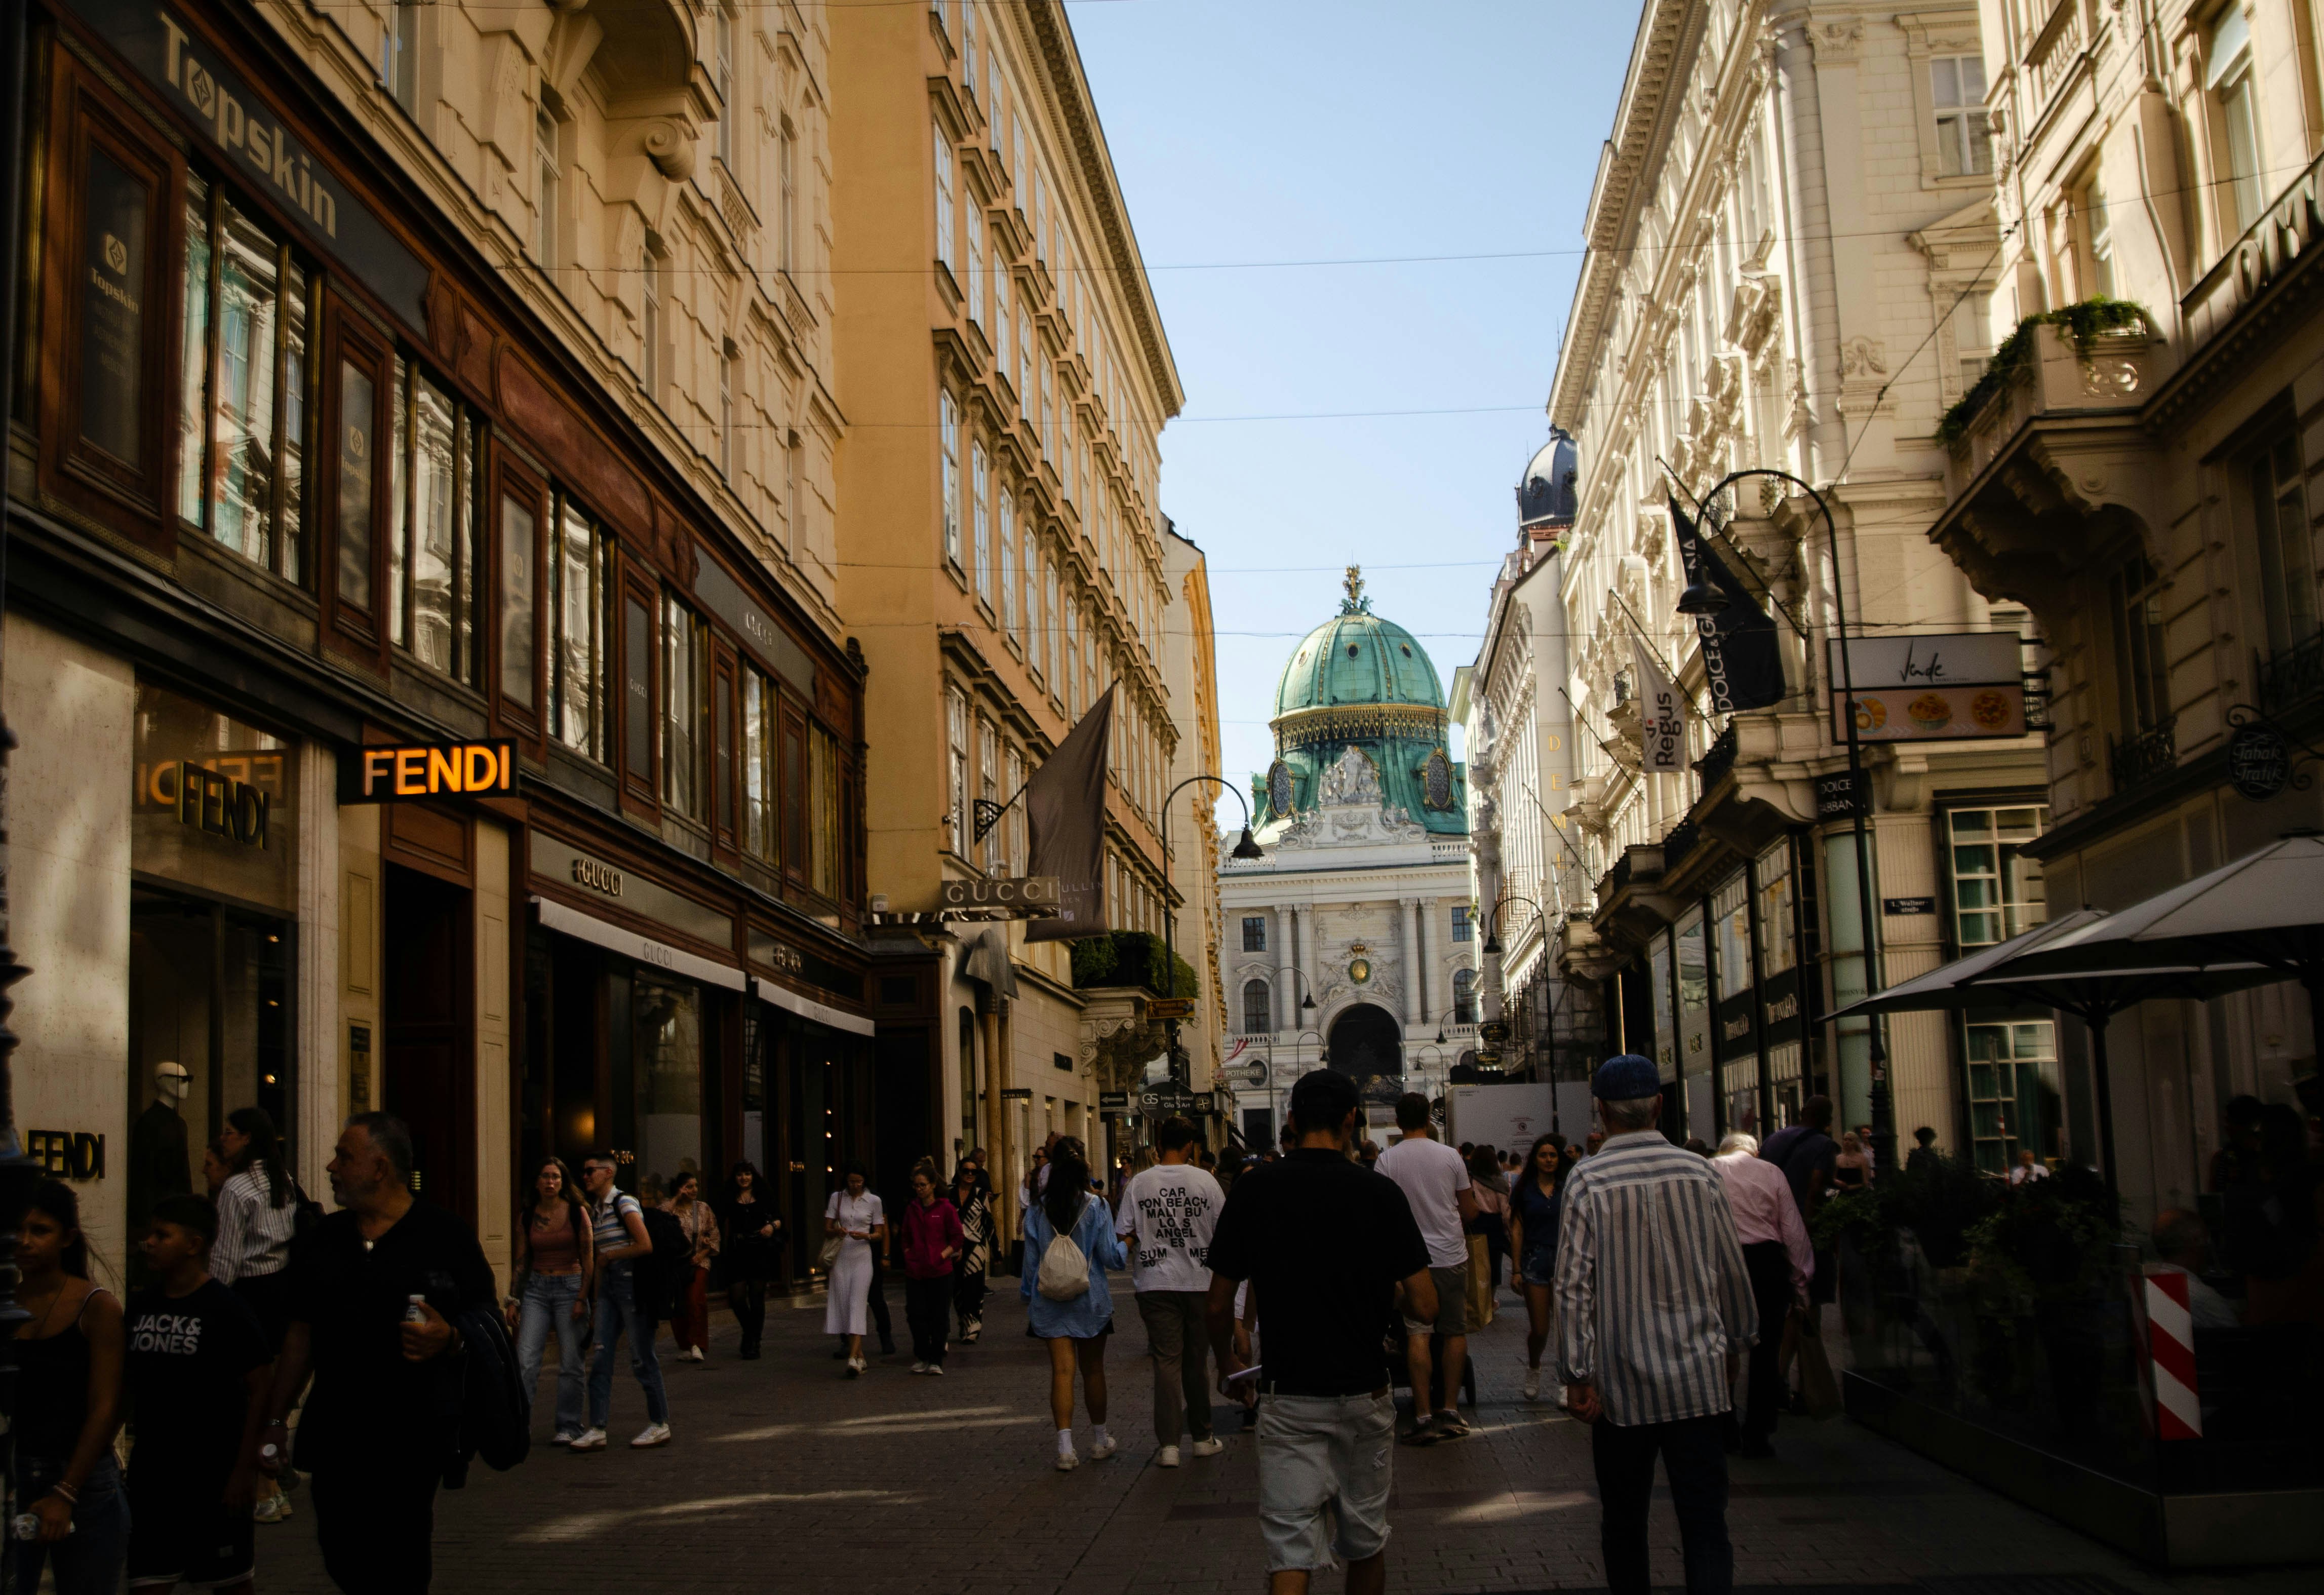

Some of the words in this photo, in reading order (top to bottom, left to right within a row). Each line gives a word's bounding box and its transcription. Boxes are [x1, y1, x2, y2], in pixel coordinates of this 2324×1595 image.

[91, 266, 139, 315] Topskin
[1705, 648, 1735, 712] DOLCE
[1656, 687, 1682, 766] Regus
[362, 743, 510, 796] FENDI
[180, 761, 269, 850] FENDI
[580, 859, 623, 892] GUCCI
[1061, 880, 1104, 893] ULLIN
[947, 881, 1053, 903] GUCCI
[644, 942, 673, 968] GUCCI
[1142, 1093, 1159, 1105] GS
[28, 1130, 105, 1180] FENDI
[1160, 1187, 1186, 1197] CAR
[1147, 1208, 1175, 1219] MALI
[1185, 1207, 1202, 1217] BU
[1166, 1196, 1210, 1211] BEACH,
[1156, 1228, 1197, 1238] ANGEL
[1159, 1218, 1175, 1228] LO
[1183, 1218, 1191, 1228] S
[1140, 1248, 1167, 1260] SUM
[1170, 1238, 1185, 1248] ES
[130, 1333, 199, 1357] JONES
